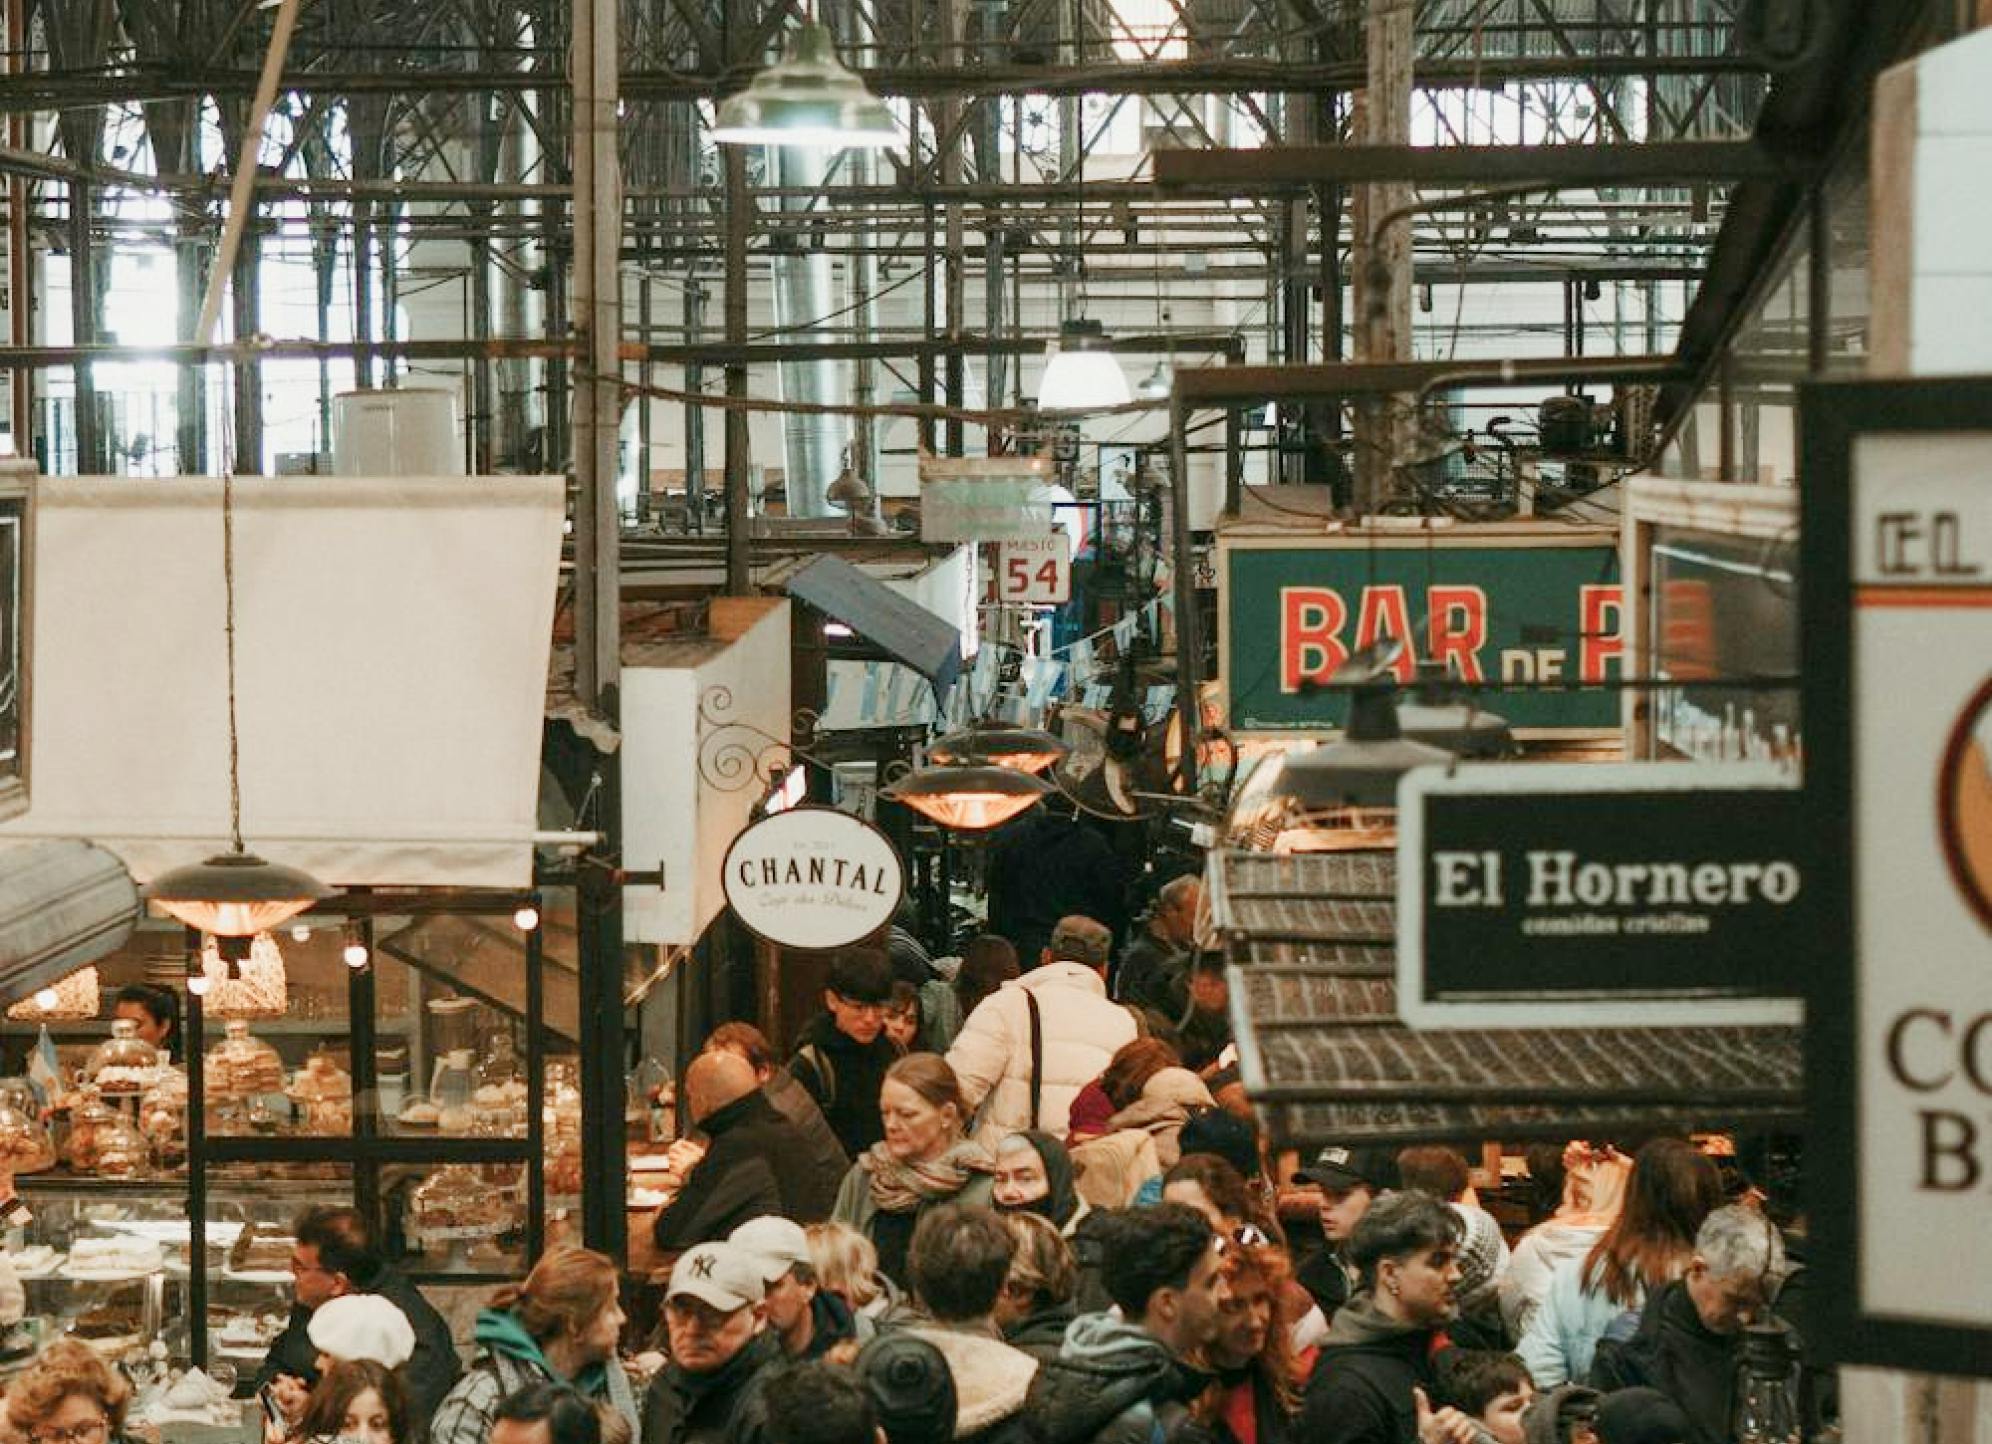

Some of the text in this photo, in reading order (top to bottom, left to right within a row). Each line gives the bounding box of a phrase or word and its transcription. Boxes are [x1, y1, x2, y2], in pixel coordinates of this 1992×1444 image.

[1876, 511, 1983, 576] EL
[1007, 558, 1058, 594] 54
[1280, 585, 1487, 694] BAR
[1501, 648, 1566, 693] DE
[739, 856, 886, 895] CHANTAL
[1433, 850, 1801, 907] El Hornero
